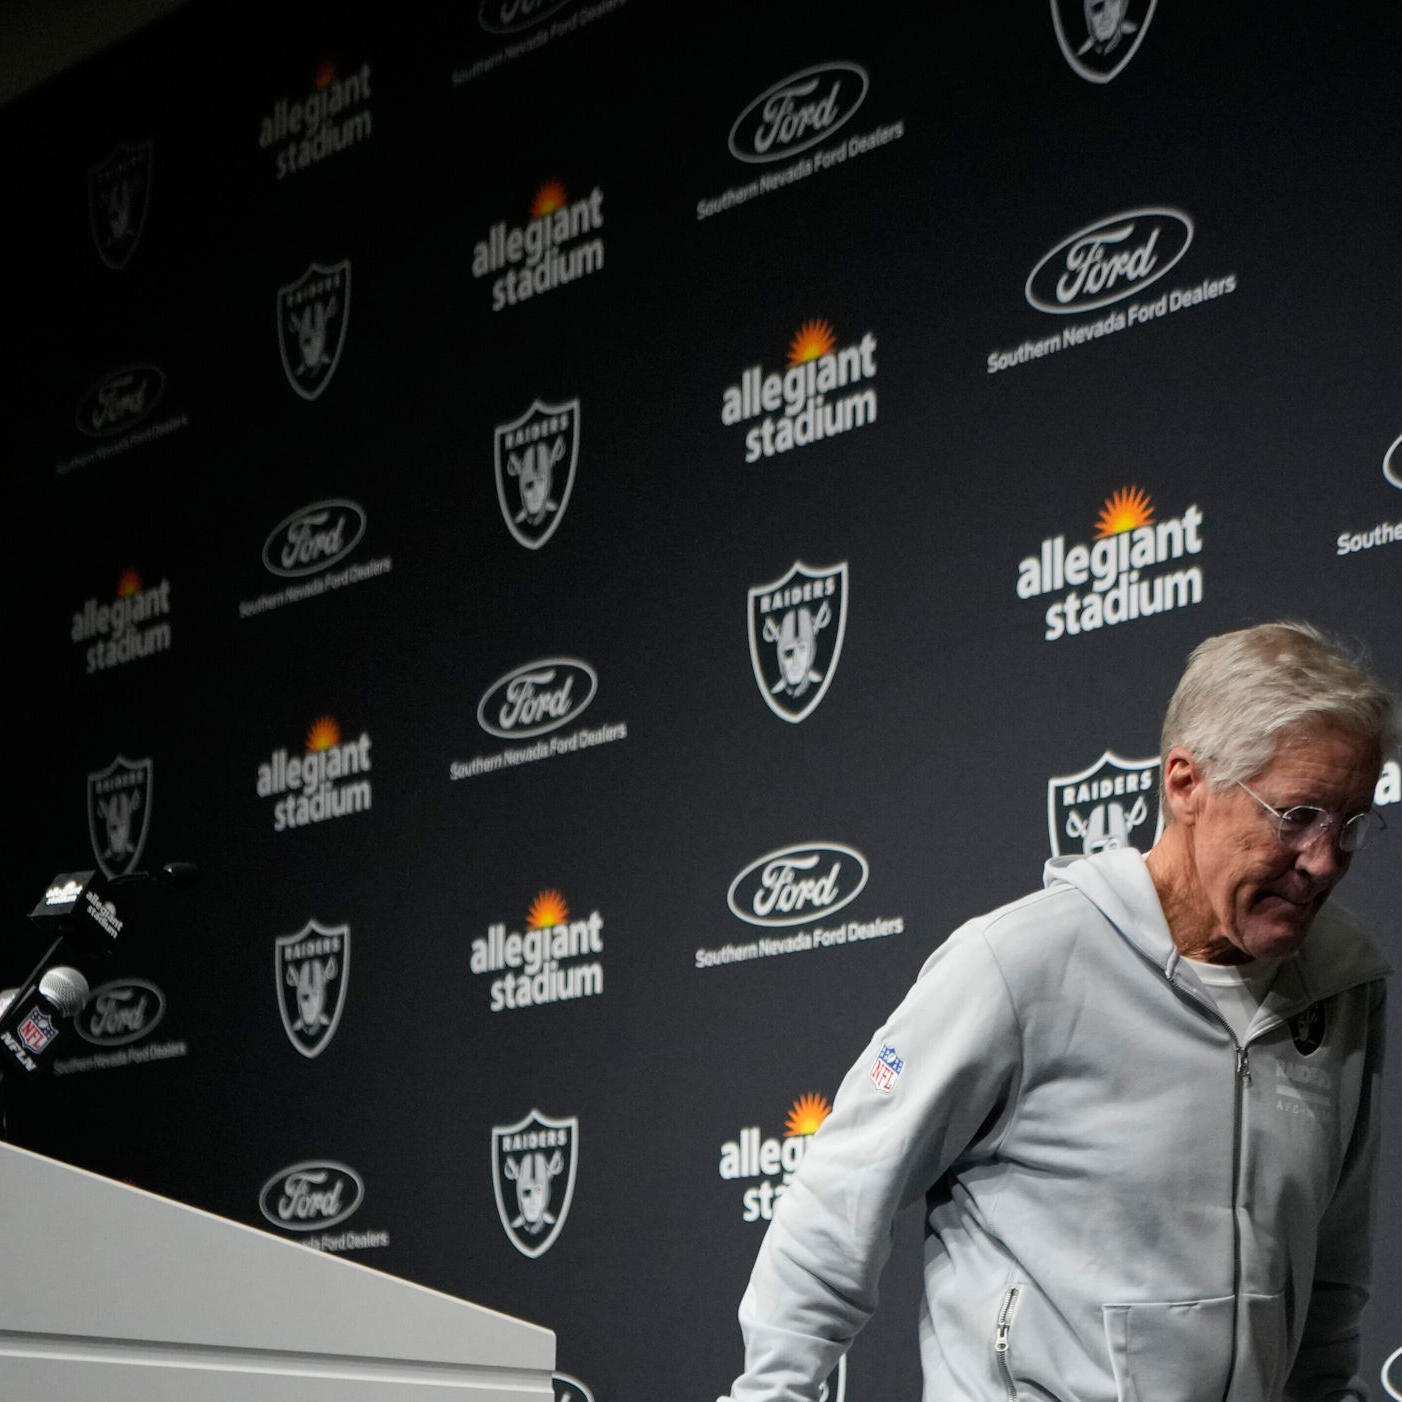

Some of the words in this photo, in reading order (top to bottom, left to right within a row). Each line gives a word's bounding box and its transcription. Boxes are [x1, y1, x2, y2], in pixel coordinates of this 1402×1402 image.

[258, 60, 372, 150] allegiant
[753, 76, 843, 154] Ford
[275, 109, 372, 181] stadium
[759, 157, 813, 196] Nevada
[813, 139, 847, 173] Ford
[848, 120, 905, 158] Dealers
[471, 184, 604, 279] allegiant
[1056, 222, 1161, 303] Ford
[492, 237, 604, 312] stadium
[987, 331, 1061, 375] Southern
[1062, 308, 1125, 349] Nevada
[1127, 291, 1167, 325] Ford
[1169, 272, 1238, 313] Dealers
[721, 330, 878, 427] allegiant
[504, 414, 570, 450] RAIDERS
[745, 387, 878, 464] stadium
[281, 509, 346, 569] Ford
[1016, 503, 1205, 600] allegiant
[70, 577, 172, 644] allegiant
[760, 577, 836, 615] RAIDERS
[1043, 566, 1204, 642] stadium
[86, 621, 173, 675] stadium
[497, 665, 573, 731] Ford
[256, 730, 373, 799] allegiant
[449, 752, 503, 782] Southern
[503, 739, 549, 766] Nevada
[549, 732, 578, 757] Ford
[578, 720, 628, 749] Dealers
[273, 777, 373, 833] stadium
[1062, 769, 1153, 807] RAIDERS
[753, 852, 841, 917] Ford
[284, 936, 341, 962] RAIDERS
[470, 909, 604, 975] allegiant
[695, 940, 759, 969] Southern
[759, 928, 812, 959] Nevada
[813, 922, 847, 950] Ford
[847, 916, 905, 945] Dealers
[90, 987, 149, 1037] Ford
[490, 958, 604, 1012] stadium
[21, 1019, 44, 1050] NFL
[871, 1059, 894, 1090] NFL
[502, 1128, 568, 1152] RAIDERS
[718, 1125, 814, 1186] alleg
[278, 1170, 344, 1219] Ford
[346, 1230, 390, 1250] Dealers
